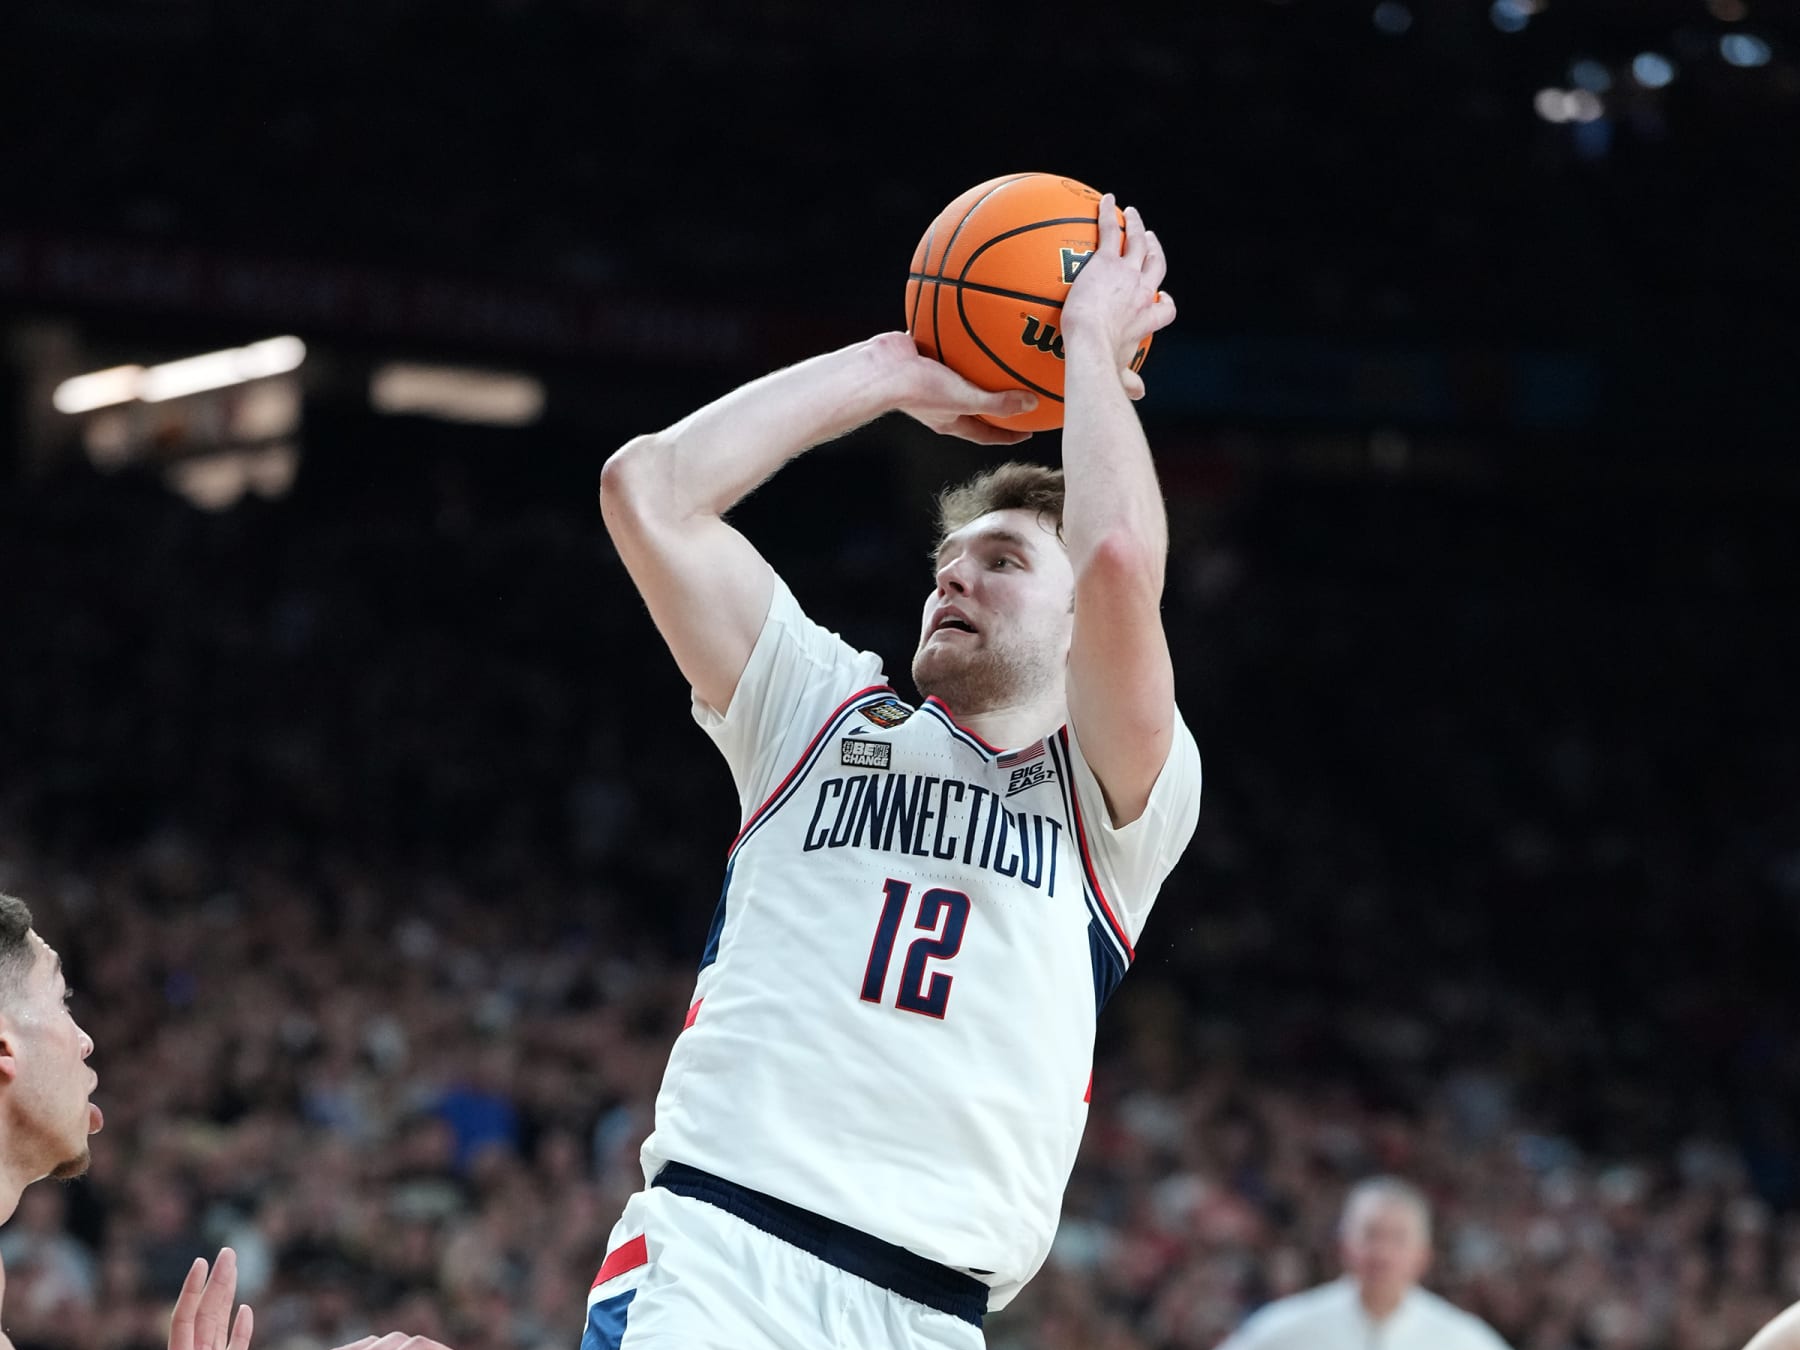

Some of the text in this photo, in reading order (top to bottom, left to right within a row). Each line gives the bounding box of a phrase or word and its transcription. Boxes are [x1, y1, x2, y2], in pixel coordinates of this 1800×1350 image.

[842, 754, 888, 767] CHANGE
[1010, 761, 1044, 781] BIG
[1007, 770, 1056, 792] EAST
[803, 774, 1062, 898] CONNECTICUT
[860, 877, 971, 1020] 12
